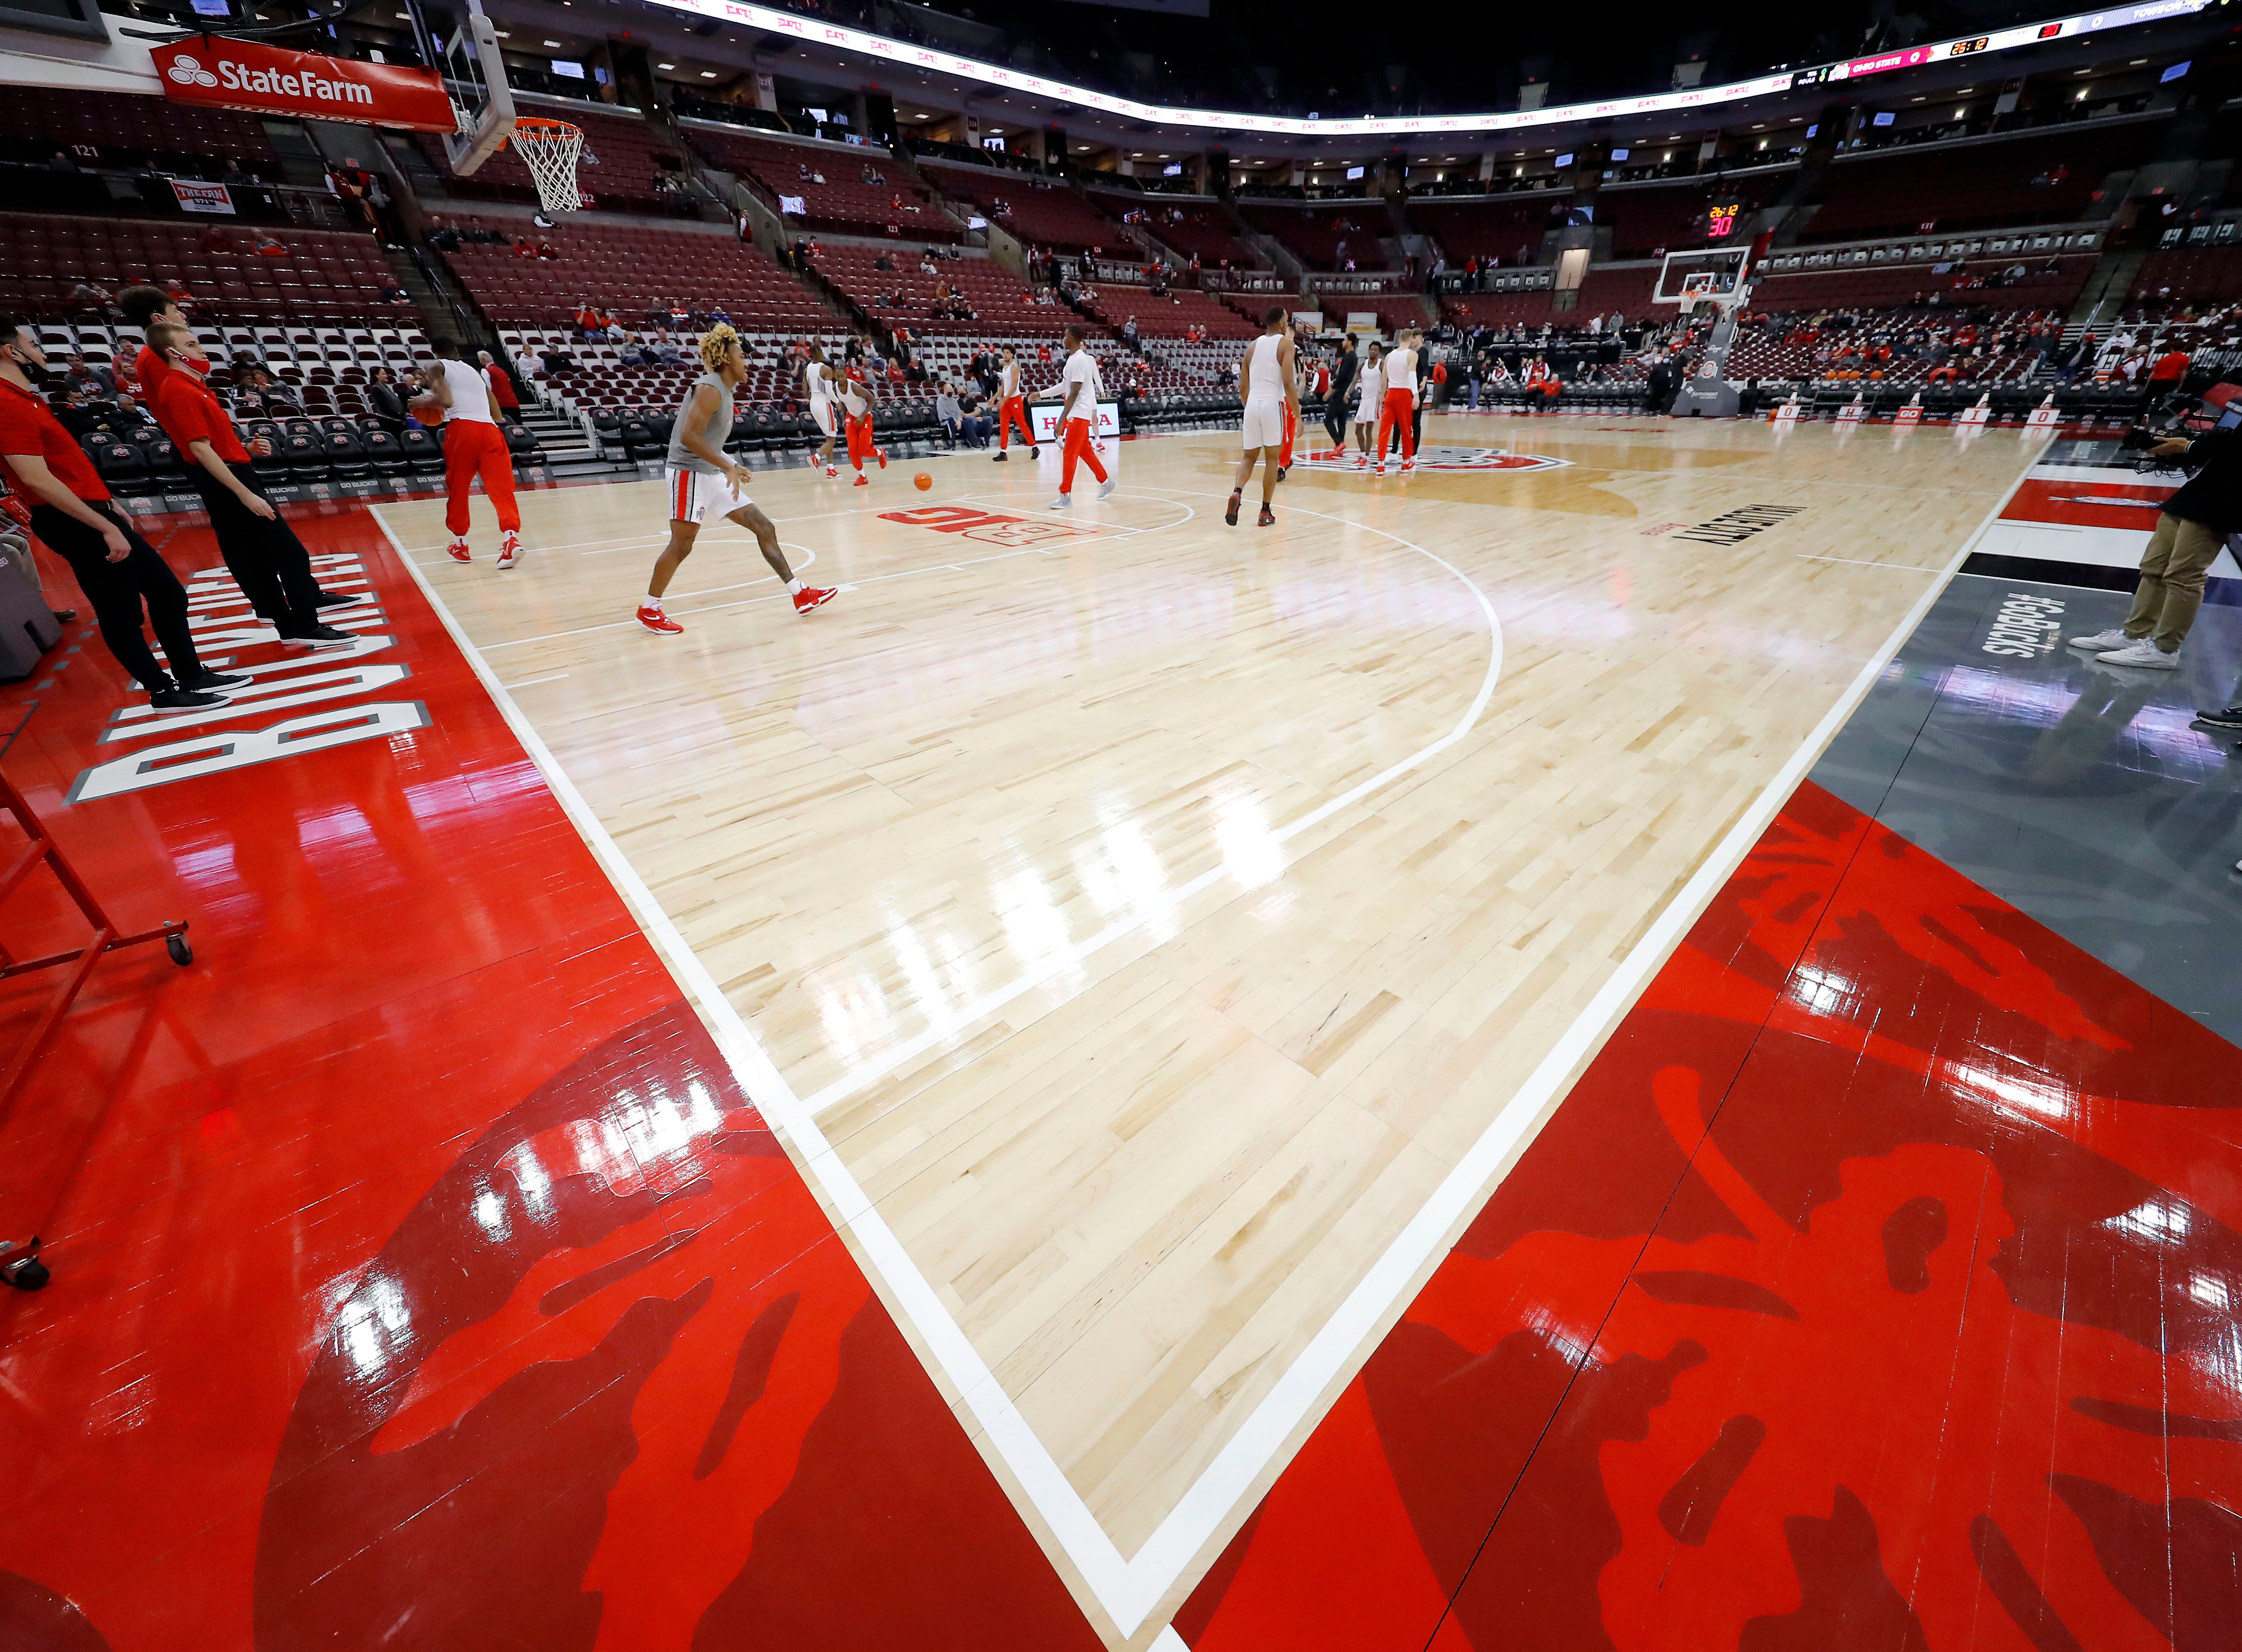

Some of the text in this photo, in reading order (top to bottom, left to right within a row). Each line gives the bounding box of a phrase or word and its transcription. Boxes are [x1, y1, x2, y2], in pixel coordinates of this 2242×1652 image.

[2041, 24, 2061, 38] 30
[1952, 38, 1988, 55] 26:12
[1853, 62, 1875, 73] OHIO
[1875, 56, 1901, 69] STATE
[71, 145, 99, 157] 121
[1709, 205, 1739, 218] 26:12
[887, 225, 898, 233] 123
[1708, 217, 1733, 237] 30
